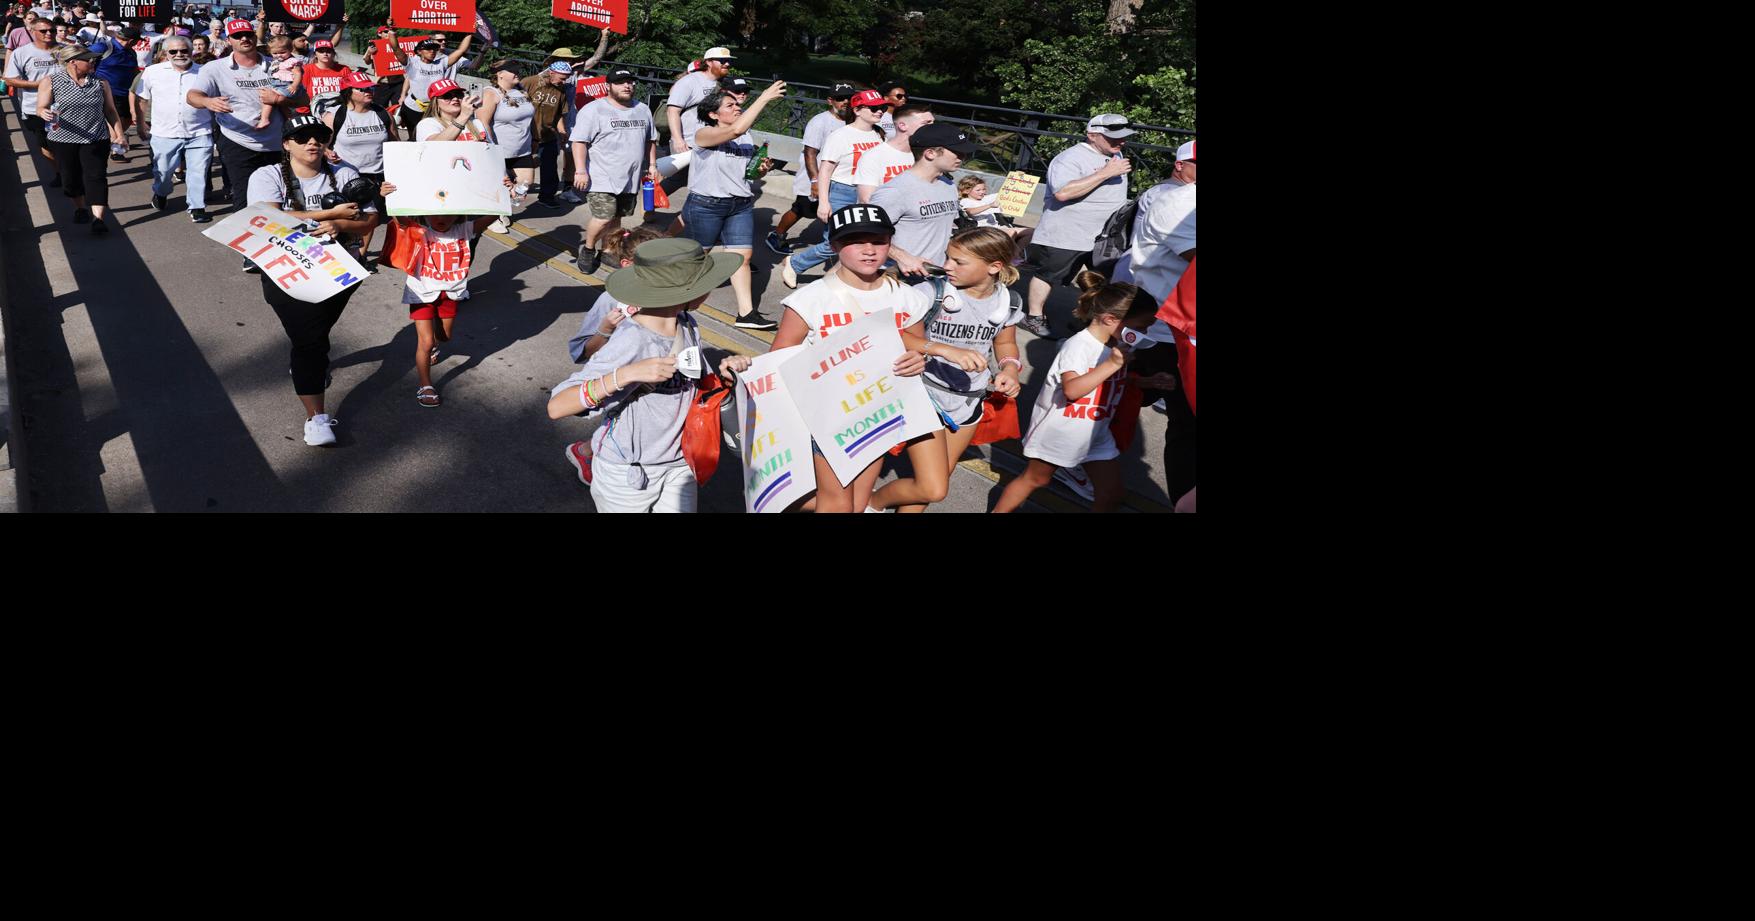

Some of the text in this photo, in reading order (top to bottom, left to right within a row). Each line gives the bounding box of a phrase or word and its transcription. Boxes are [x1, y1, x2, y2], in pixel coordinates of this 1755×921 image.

[119, 6, 156, 18] FOR LIFE
[290, 4, 322, 18] MARCH
[420, 0, 447, 10] OVER
[570, 1, 611, 24] ABORTION
[230, 21, 250, 30] LIFE
[411, 9, 457, 26] ABORTION
[311, 76, 322, 87] WE
[533, 91, 557, 104] 3:16
[833, 207, 882, 230] LIFE
[919, 202, 946, 217] CITIZENS
[228, 231, 310, 290] LIFE
[249, 215, 359, 287] GENERATION
[268, 235, 314, 270] CHOOSES
[930, 320, 997, 341] CITIZENS FOR
[810, 335, 874, 381] JUNE
[845, 369, 867, 386] IS
[840, 375, 894, 415] LIFE
[834, 398, 906, 447] MONTH
